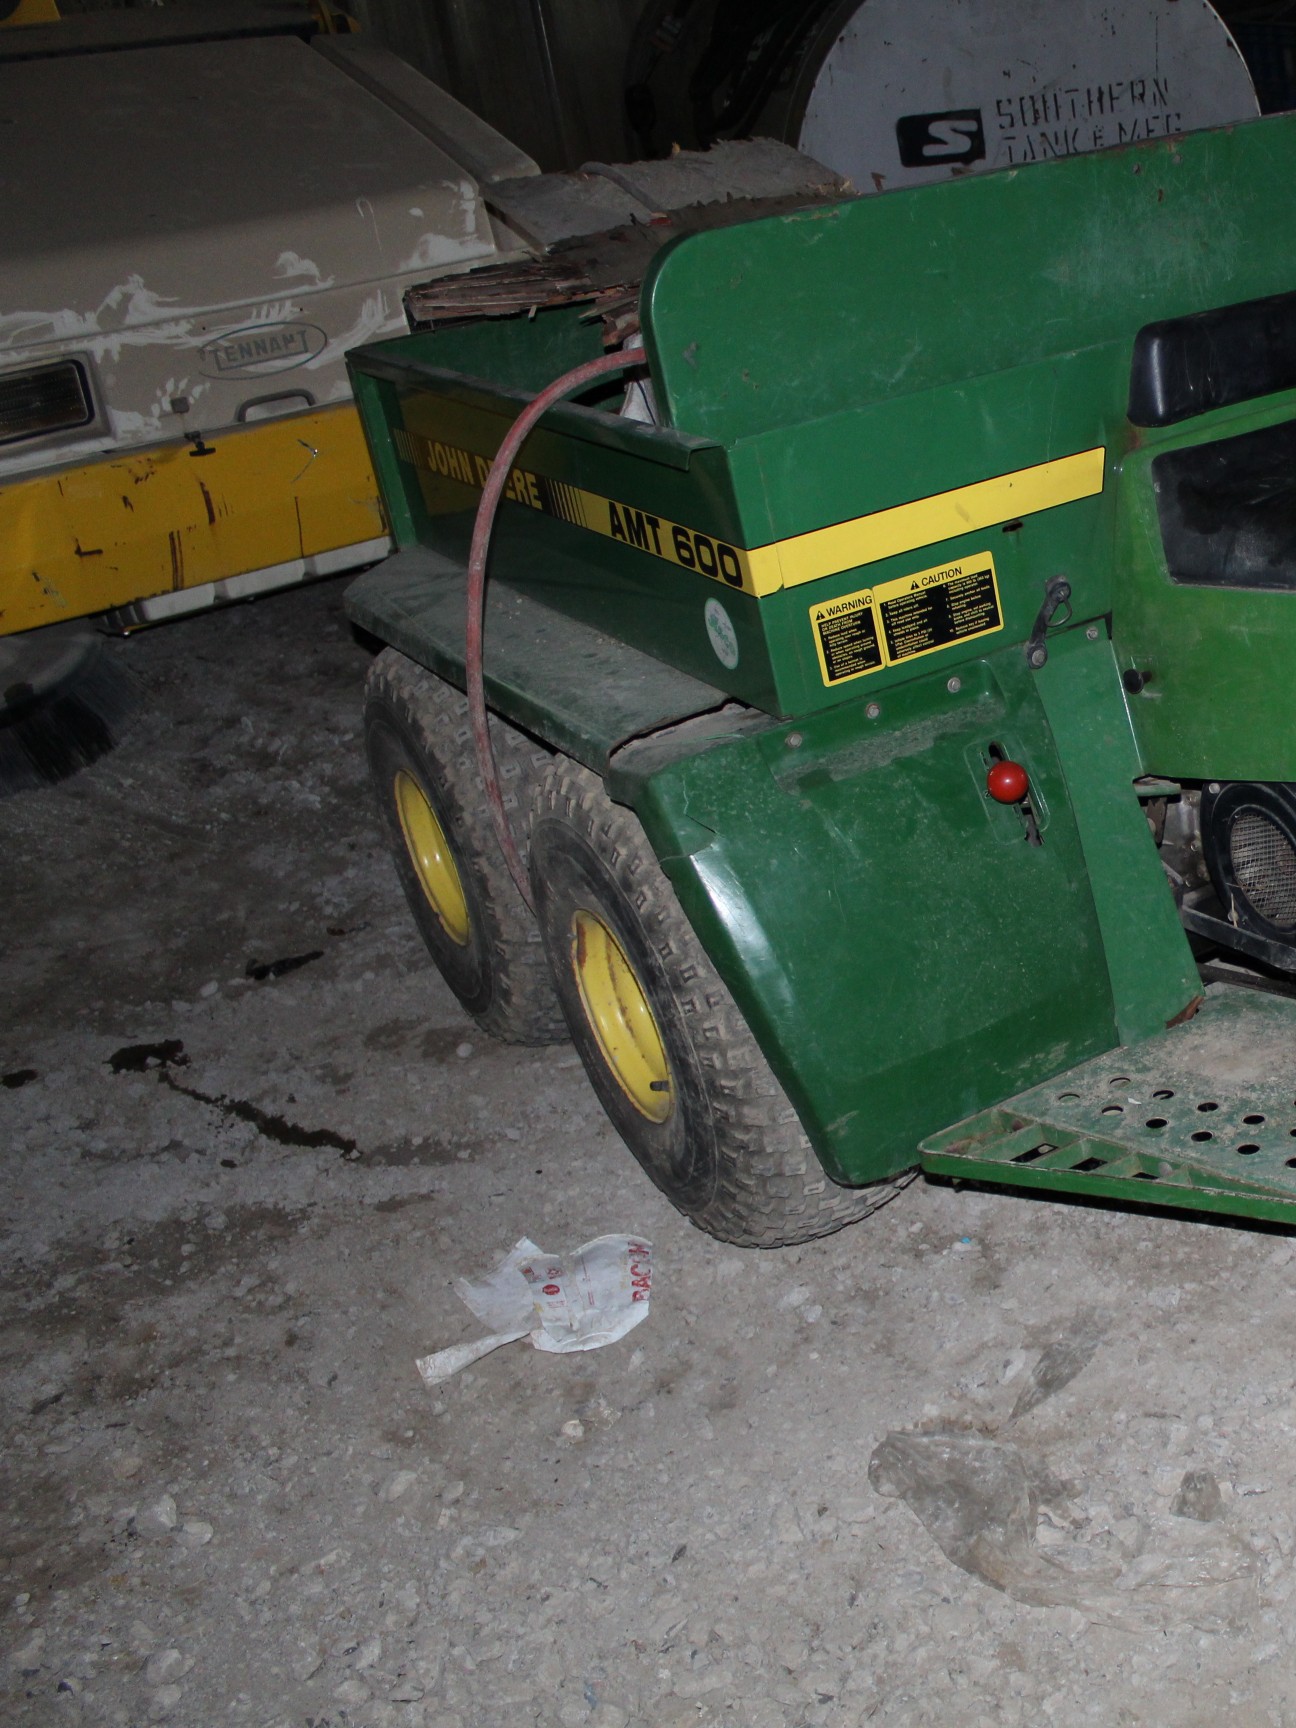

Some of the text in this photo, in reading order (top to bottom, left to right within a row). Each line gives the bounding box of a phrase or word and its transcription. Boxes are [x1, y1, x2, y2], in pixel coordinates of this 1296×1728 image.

[427, 440, 543, 510] JOHN DRE
[609, 501, 743, 588] AMT 600
[921, 566, 963, 587] CAUTION
[826, 595, 873, 617] WARNING
